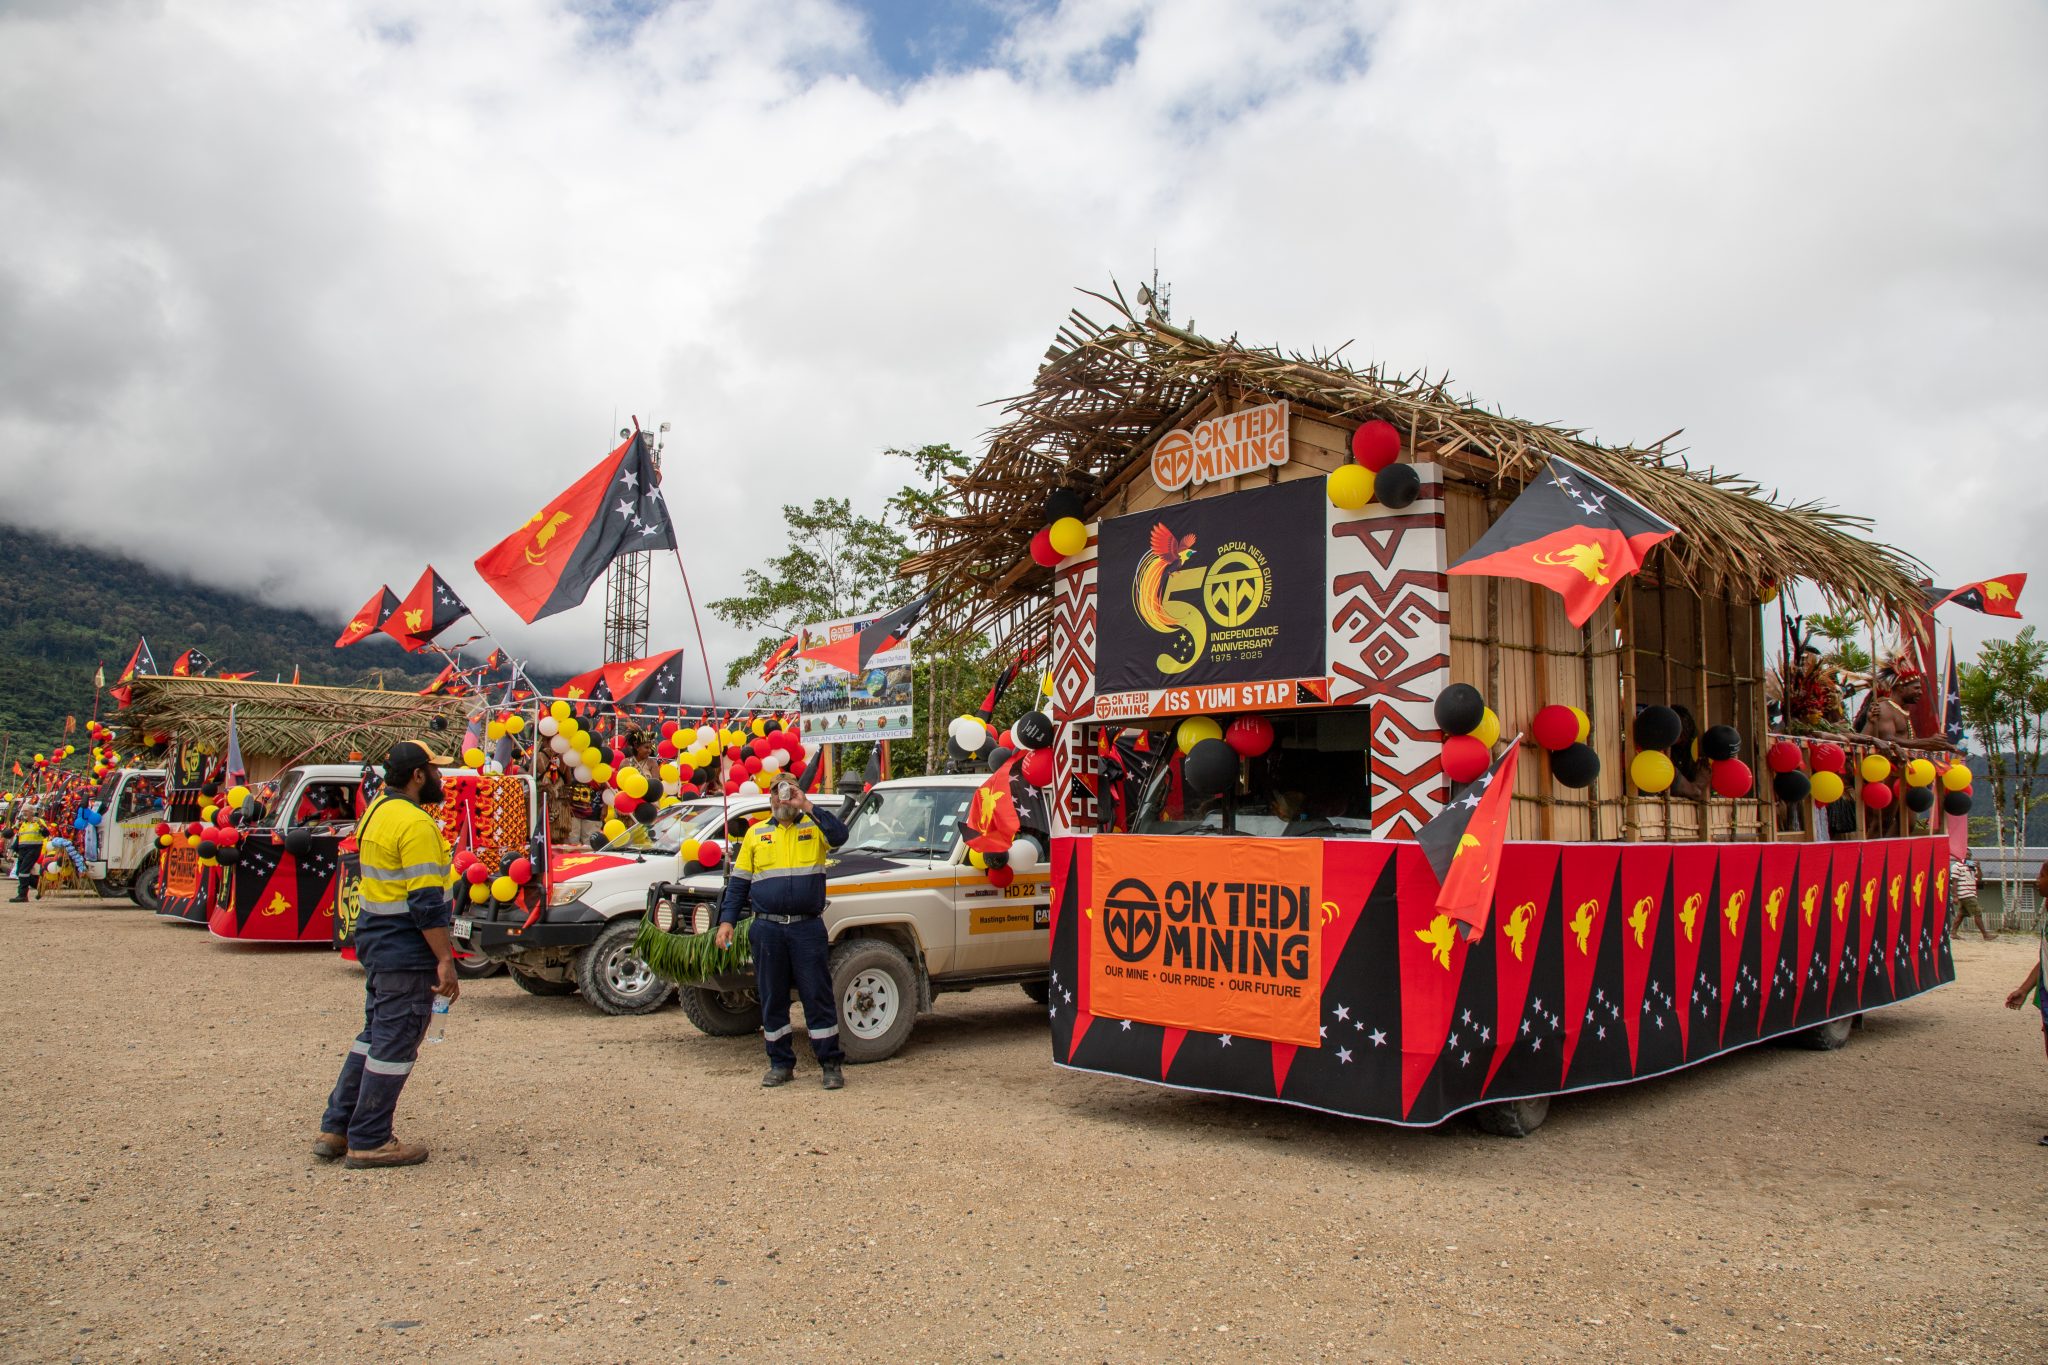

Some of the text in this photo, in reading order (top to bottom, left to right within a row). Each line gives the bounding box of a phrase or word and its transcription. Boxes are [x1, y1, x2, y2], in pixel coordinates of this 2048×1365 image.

[1194, 403, 1285, 451] OK TEDI
[1195, 431, 1285, 481] MINING
[1217, 541, 1273, 608] PAPUA NEW GUINEA
[1210, 625, 1279, 642] INDEPENDENCE
[1210, 638, 1274, 653] ANNIVERSARY
[1210, 653, 1232, 663] 1975
[1240, 650, 1263, 660] 2025
[1111, 692, 1149, 706] OK TEDI
[1164, 683, 1290, 711] ISS YUMI STAP
[1111, 703, 1149, 717] MINING
[1004, 885, 1020, 897] HD
[1023, 884, 1035, 896] 22
[1164, 880, 1311, 932] OK TEDI
[979, 913, 1030, 924] Hastings Deering
[1162, 924, 1310, 981] MINING
[1104, 964, 1302, 998] OUR MINE OUR PRIDE OUR FUTURE
